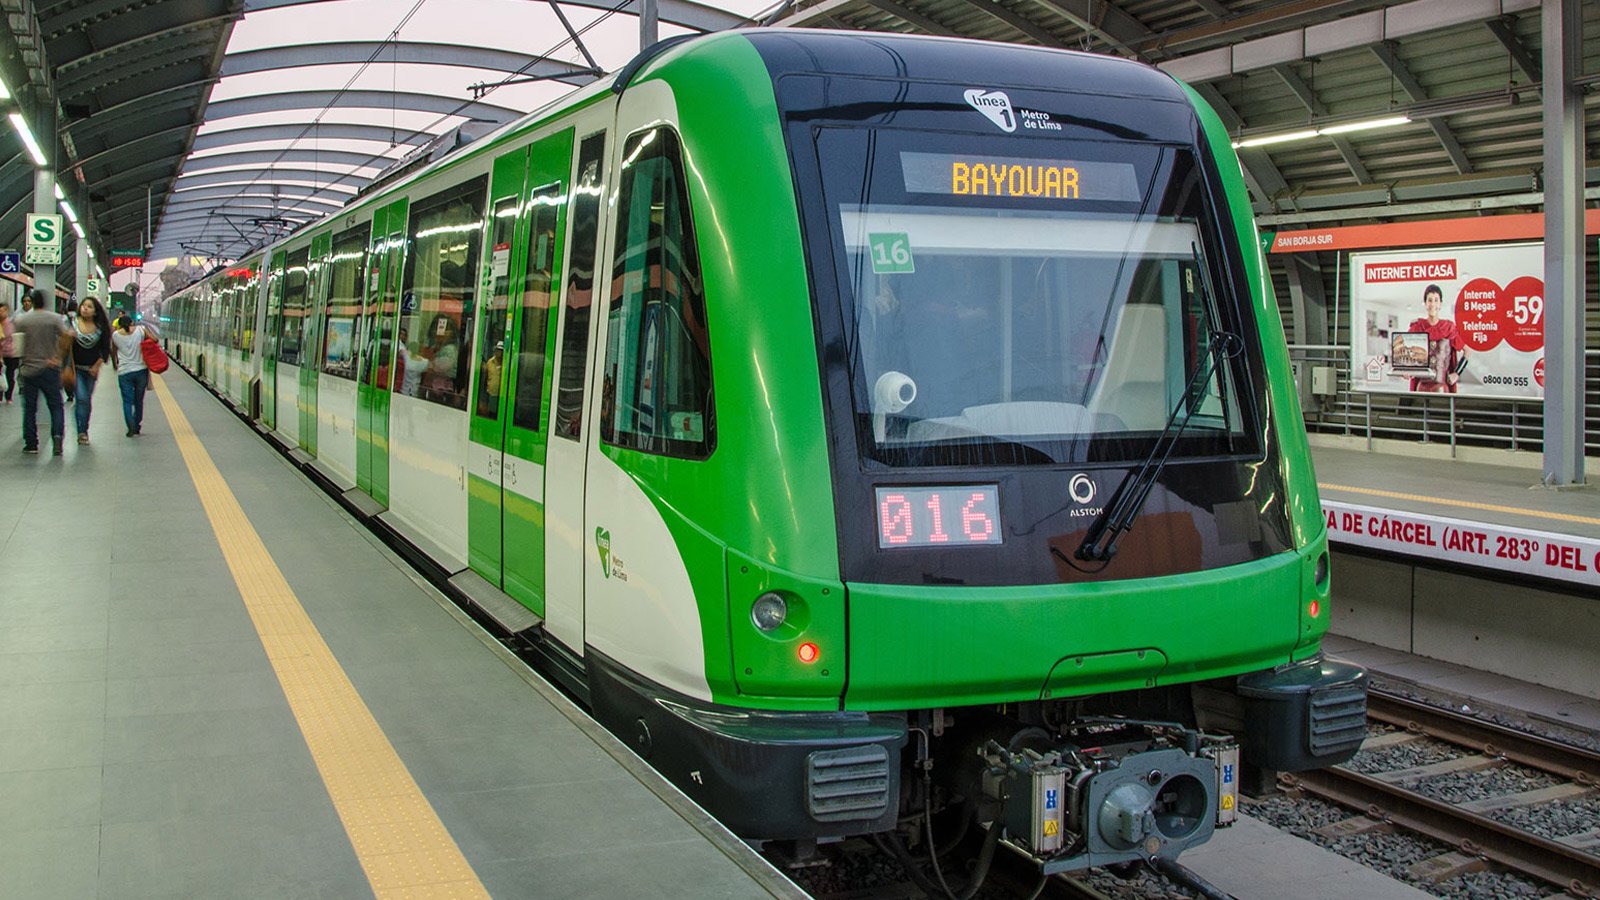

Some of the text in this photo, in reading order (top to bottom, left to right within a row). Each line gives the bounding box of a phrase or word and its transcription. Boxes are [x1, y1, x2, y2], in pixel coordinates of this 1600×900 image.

[1000, 109, 1012, 127] 1
[1021, 110, 1049, 120] Metro
[1024, 120, 1062, 130] de Lima
[33, 218, 55, 242] S
[1278, 234, 1333, 246] SAN BORJA SUR
[873, 240, 909, 264] 16
[1367, 264, 1454, 280] INTERNET EN CASA
[88, 280, 97, 291] S
[1464, 290, 1496, 300] Internet
[1464, 301, 1496, 312] 8 Megas
[1514, 295, 1543, 325] 59
[1473, 332, 1488, 344] Fija
[1483, 375, 1529, 387] 0800 00 555
[881, 493, 993, 543] 016
[1070, 508, 1103, 517] ALSTOM
[1323, 509, 1337, 530] A
[1342, 513, 1363, 534] DE
[1367, 514, 1436, 546] CÁRCEL
[1442, 526, 1489, 555] (ART.
[1545, 543, 1587, 571] DEL
